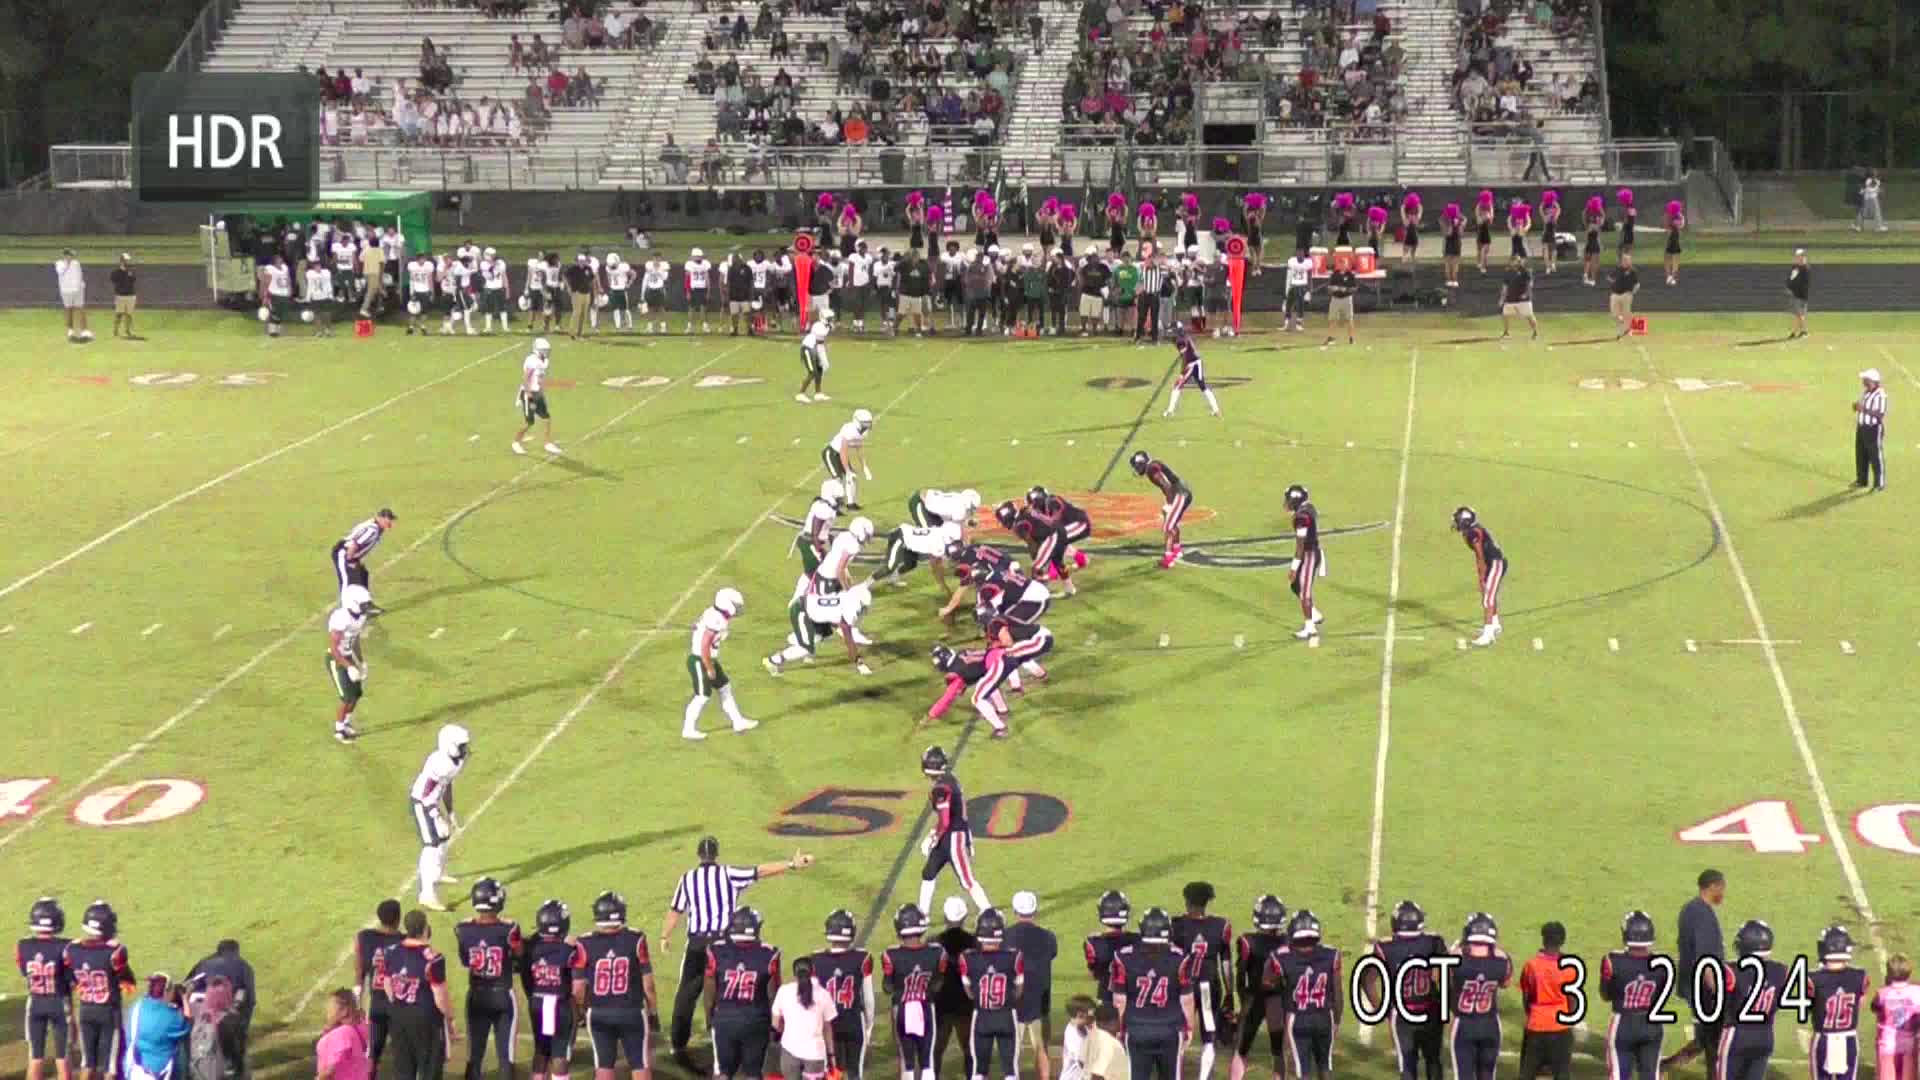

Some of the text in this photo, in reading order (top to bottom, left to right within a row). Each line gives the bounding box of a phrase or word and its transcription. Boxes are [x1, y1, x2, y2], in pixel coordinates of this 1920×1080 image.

[765, 786, 1073, 841] 50
[595, 956, 630, 996] 68
[979, 974, 1007, 1009] 19
[1135, 975, 1168, 1009] 74
[1293, 972, 1328, 1010] 44
[1822, 991, 1856, 1030] 15
